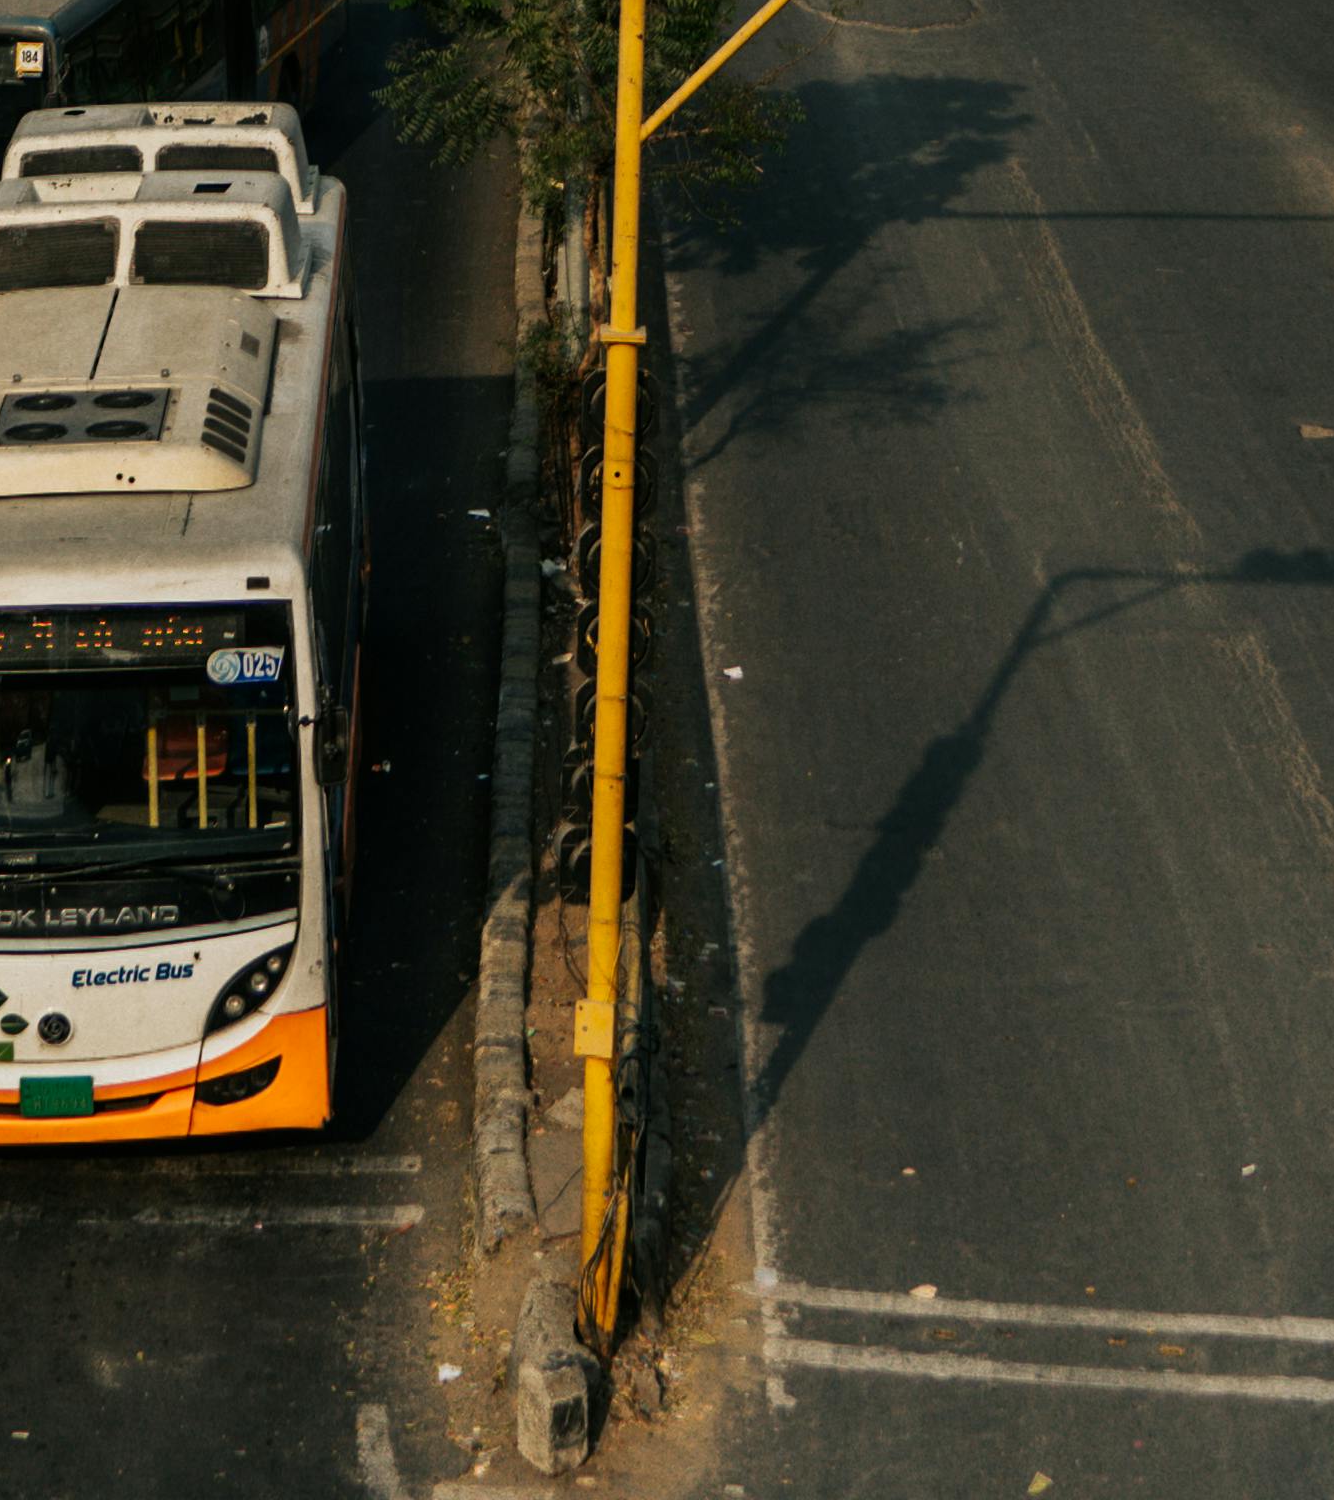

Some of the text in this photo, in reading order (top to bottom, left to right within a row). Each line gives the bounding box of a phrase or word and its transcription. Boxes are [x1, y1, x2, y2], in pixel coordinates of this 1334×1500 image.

[22, 50, 38, 62] 184
[242, 651, 276, 679] 025
[45, 905, 180, 927] LEYLAND
[71, 963, 194, 988] Electric Bus
